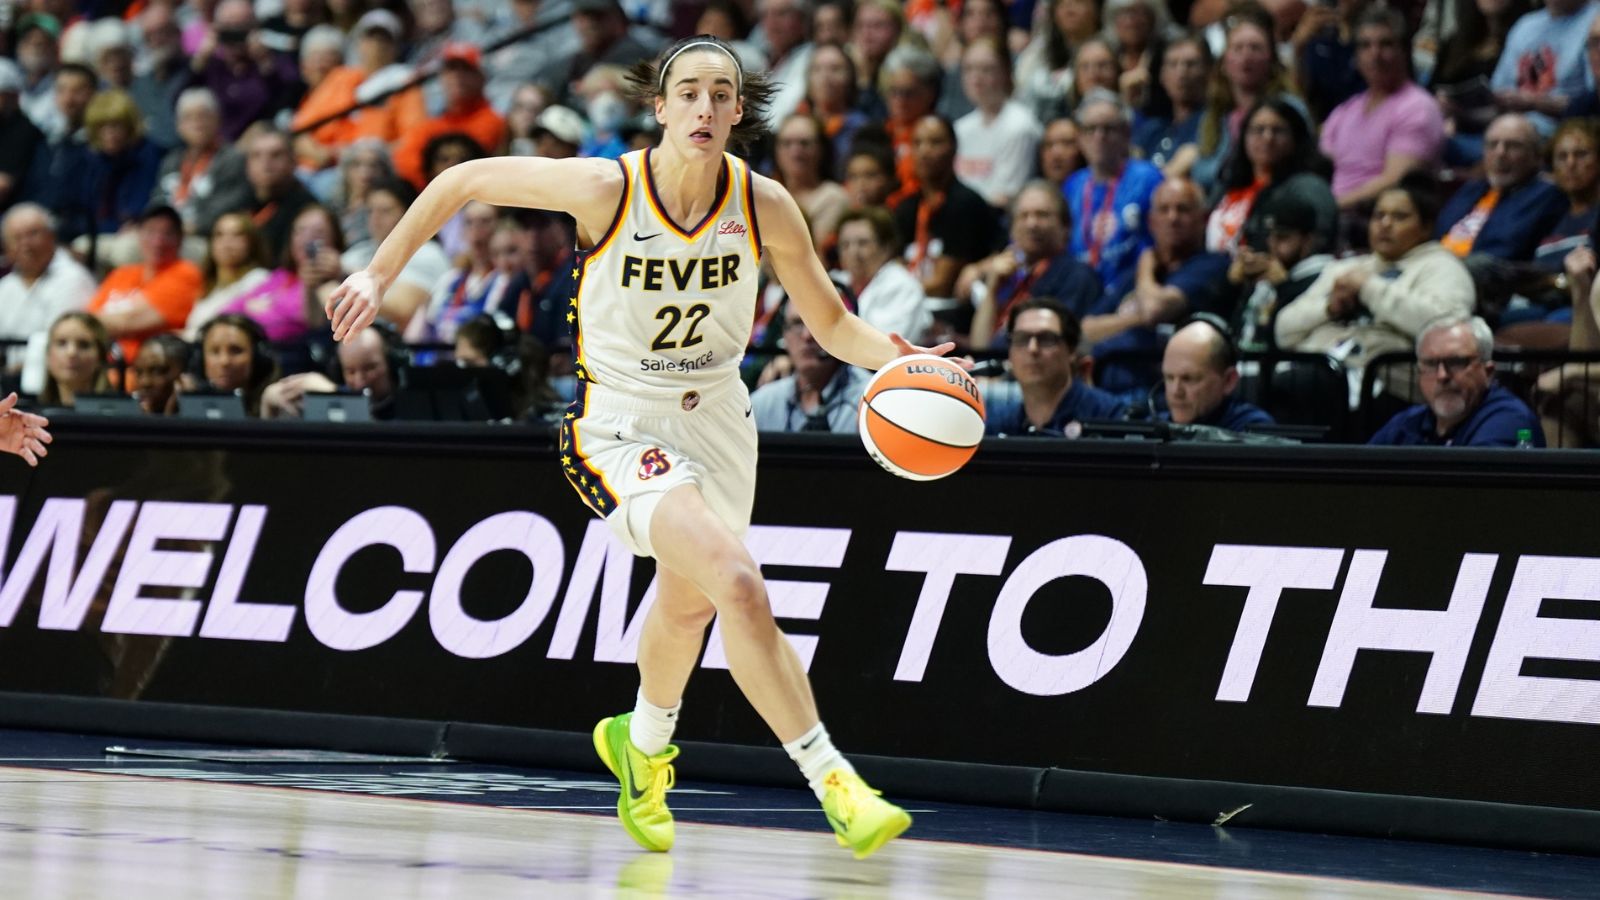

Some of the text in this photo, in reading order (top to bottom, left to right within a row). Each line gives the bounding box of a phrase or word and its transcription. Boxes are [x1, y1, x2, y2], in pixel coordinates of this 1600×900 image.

[718, 220, 747, 237] Lilly
[620, 254, 741, 292] FEVER
[650, 302, 711, 351] 22
[885, 531, 1148, 696] TO
[1202, 543, 1600, 724] THE
